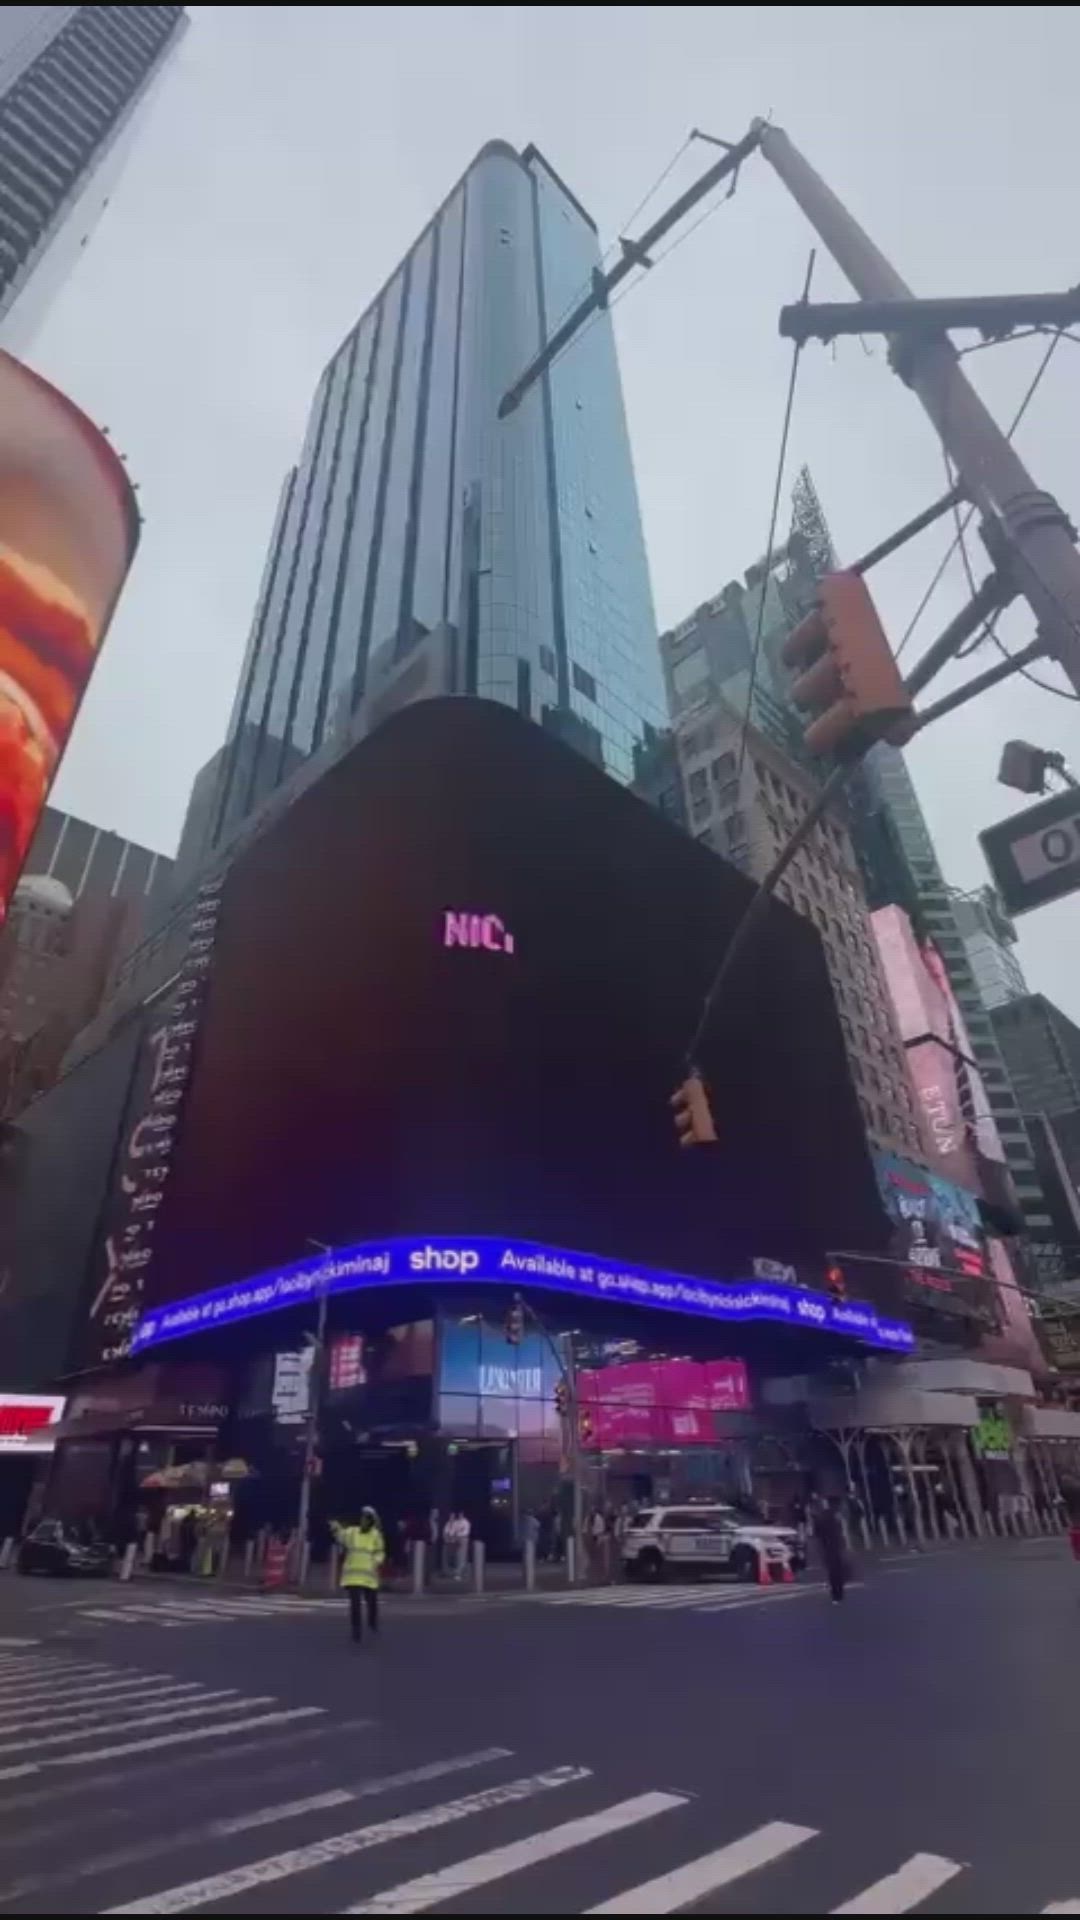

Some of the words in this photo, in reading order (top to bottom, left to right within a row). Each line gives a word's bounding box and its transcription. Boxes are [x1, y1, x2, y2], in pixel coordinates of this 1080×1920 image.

[409, 1245, 480, 1275] shop
[500, 1249, 577, 1280] Available
[797, 1298, 826, 1325] shop
